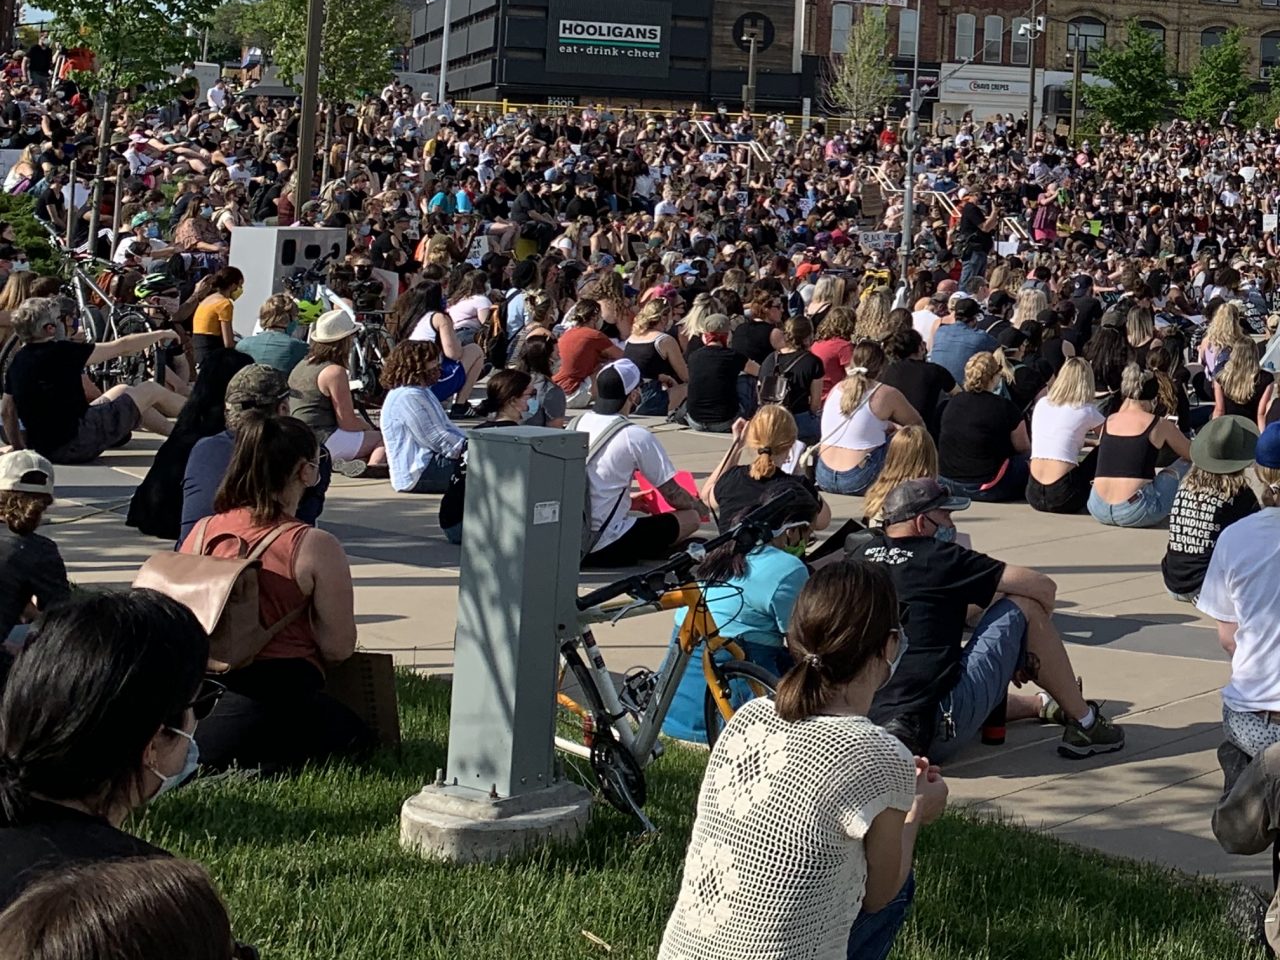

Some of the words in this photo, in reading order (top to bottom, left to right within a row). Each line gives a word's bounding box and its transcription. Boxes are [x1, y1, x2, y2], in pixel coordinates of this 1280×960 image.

[561, 22, 659, 41] HOOLIGANS
[559, 44, 578, 54] eat
[586, 45, 619, 57] drink
[627, 48, 661, 59] cheer
[1181, 498, 1217, 514] RACSM
[1180, 507, 1214, 522] SEXISM
[1175, 515, 1221, 533] KINDNESS
[1182, 525, 1211, 540] PEACE
[1175, 533, 1216, 548] EQUALITY
[1183, 542, 1205, 554] LOVE
